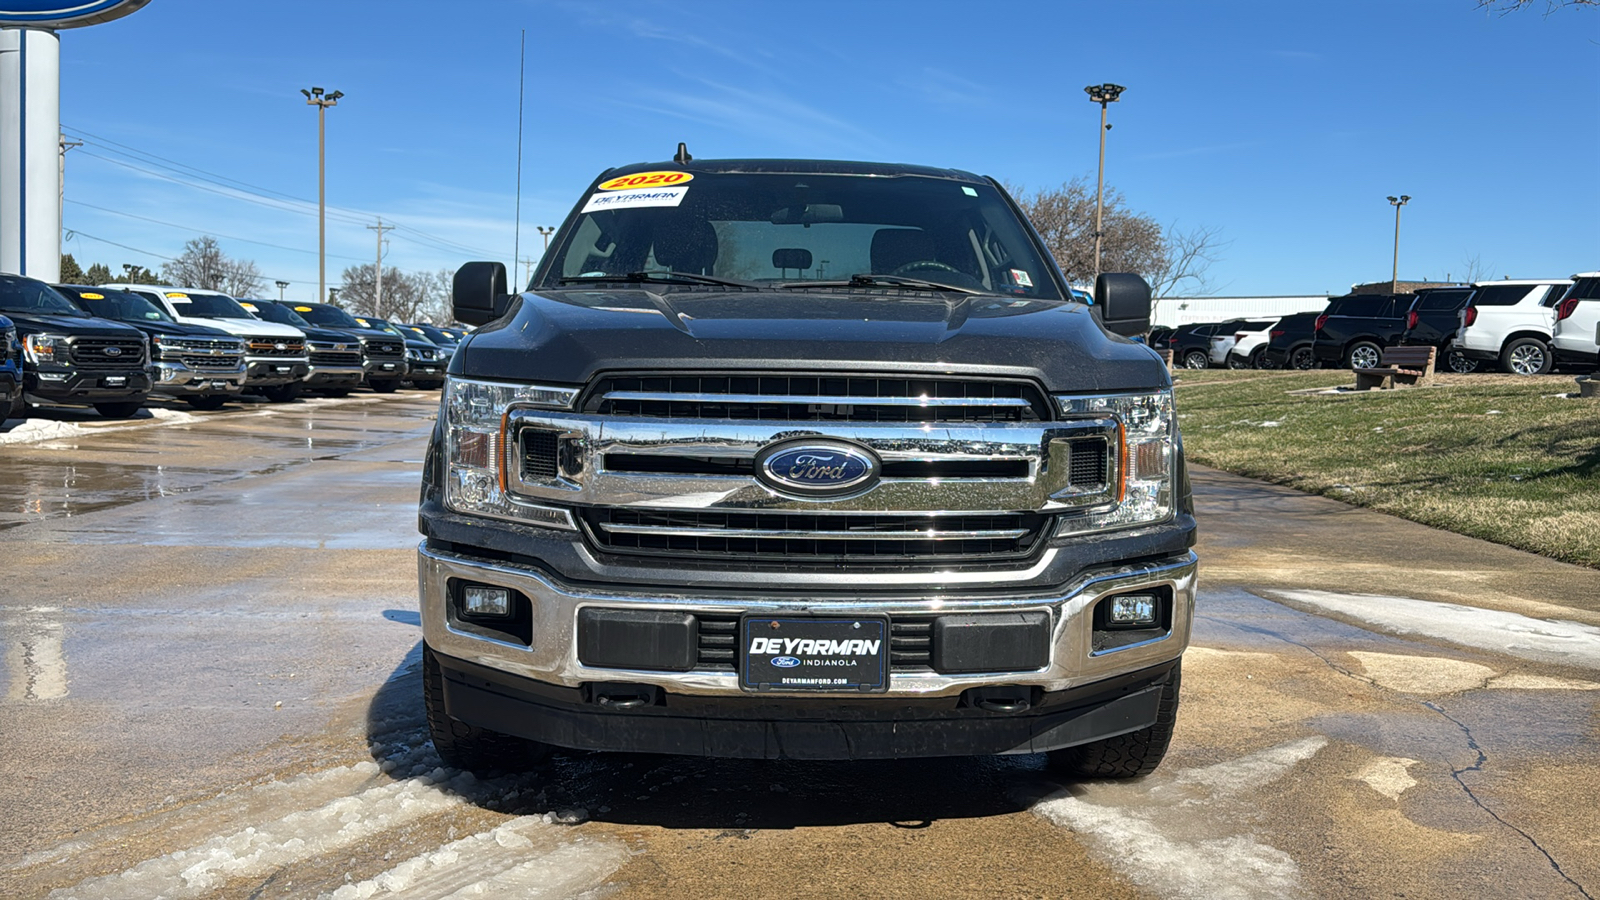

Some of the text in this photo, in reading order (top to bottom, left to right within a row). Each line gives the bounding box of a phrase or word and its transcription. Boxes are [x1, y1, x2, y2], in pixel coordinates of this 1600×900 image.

[607, 174, 684, 189] 2020
[593, 192, 680, 204] DEYARMAN
[789, 454, 848, 479] Ford
[749, 638, 881, 655] DEYARMAN
[775, 657, 795, 666] Ford
